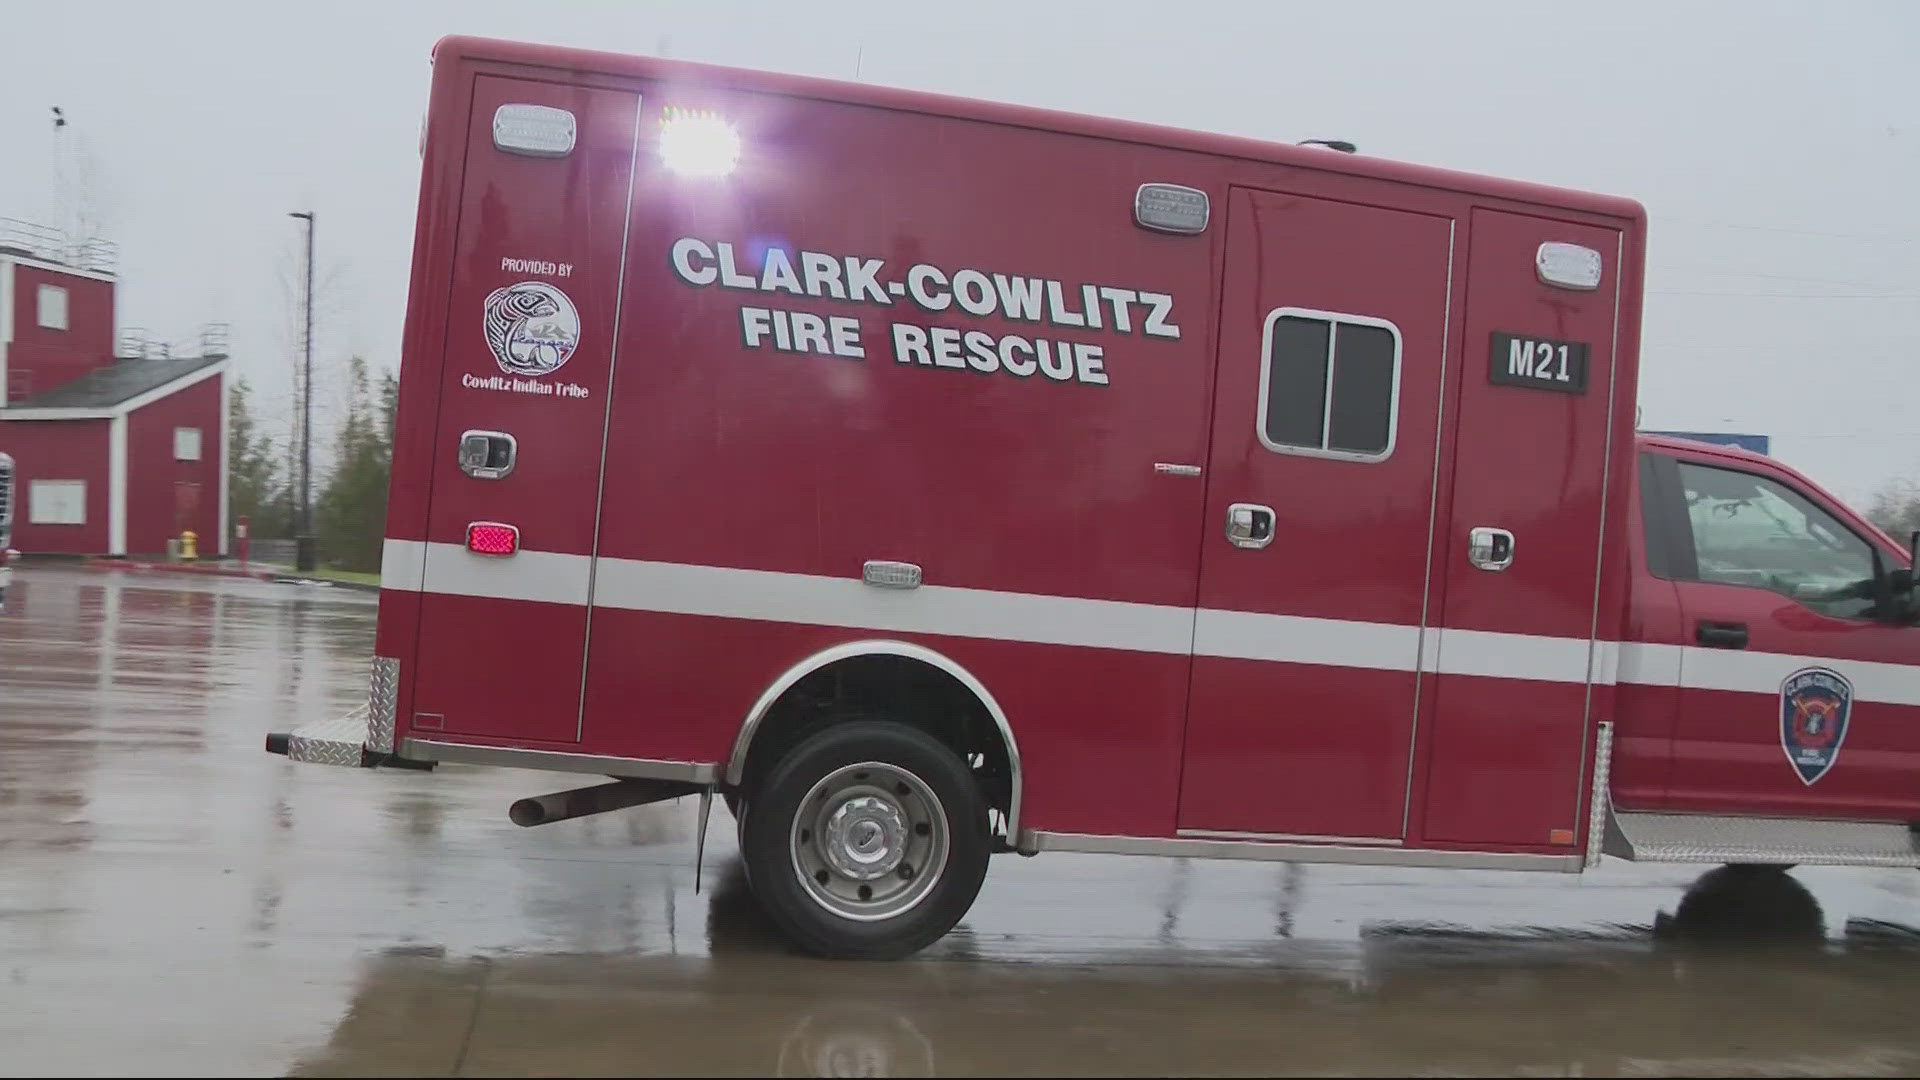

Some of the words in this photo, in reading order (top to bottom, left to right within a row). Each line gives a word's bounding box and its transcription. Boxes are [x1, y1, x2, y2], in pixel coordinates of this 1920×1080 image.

[501, 257, 556, 275] PROVIDED
[558, 263, 573, 277] BY
[672, 237, 1181, 338] CLARK-COWLITZ
[741, 306, 866, 359] FIRE
[891, 323, 1109, 385] RESCUE
[1508, 338, 1570, 382] M21
[462, 373, 512, 390] Cowlitz
[512, 378, 553, 394] Indian
[555, 382, 589, 398] Tribe
